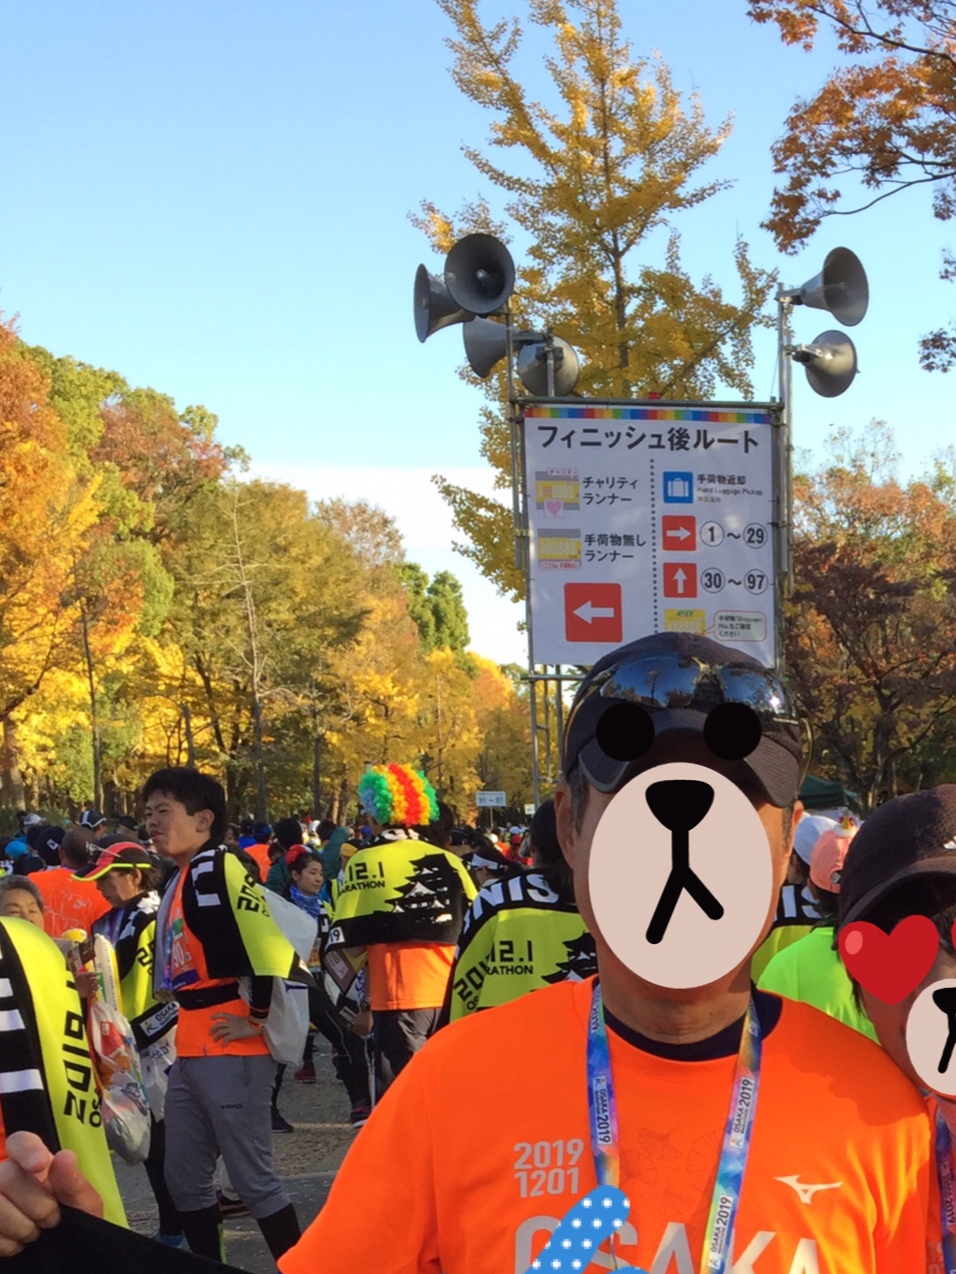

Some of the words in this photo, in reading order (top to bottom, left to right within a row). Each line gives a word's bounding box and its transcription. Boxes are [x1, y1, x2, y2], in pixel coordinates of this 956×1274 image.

[537, 425, 759, 454] フィニッシュ後ルート
[582, 476, 638, 490] チャリティ
[582, 492, 633, 506] ランナー
[584, 533, 646, 548] 手荷物無し
[584, 550, 634, 564] ランナー
[733, 1107, 744, 1133] OSAKA
[739, 1078, 753, 1108] 2019
[597, 1114, 611, 1143] 2019
[514, 1138, 585, 1170] 2019
[514, 1167, 581, 1199] 1201
[710, 1226, 721, 1253] OSAKA
[717, 1196, 732, 1226] 2019
